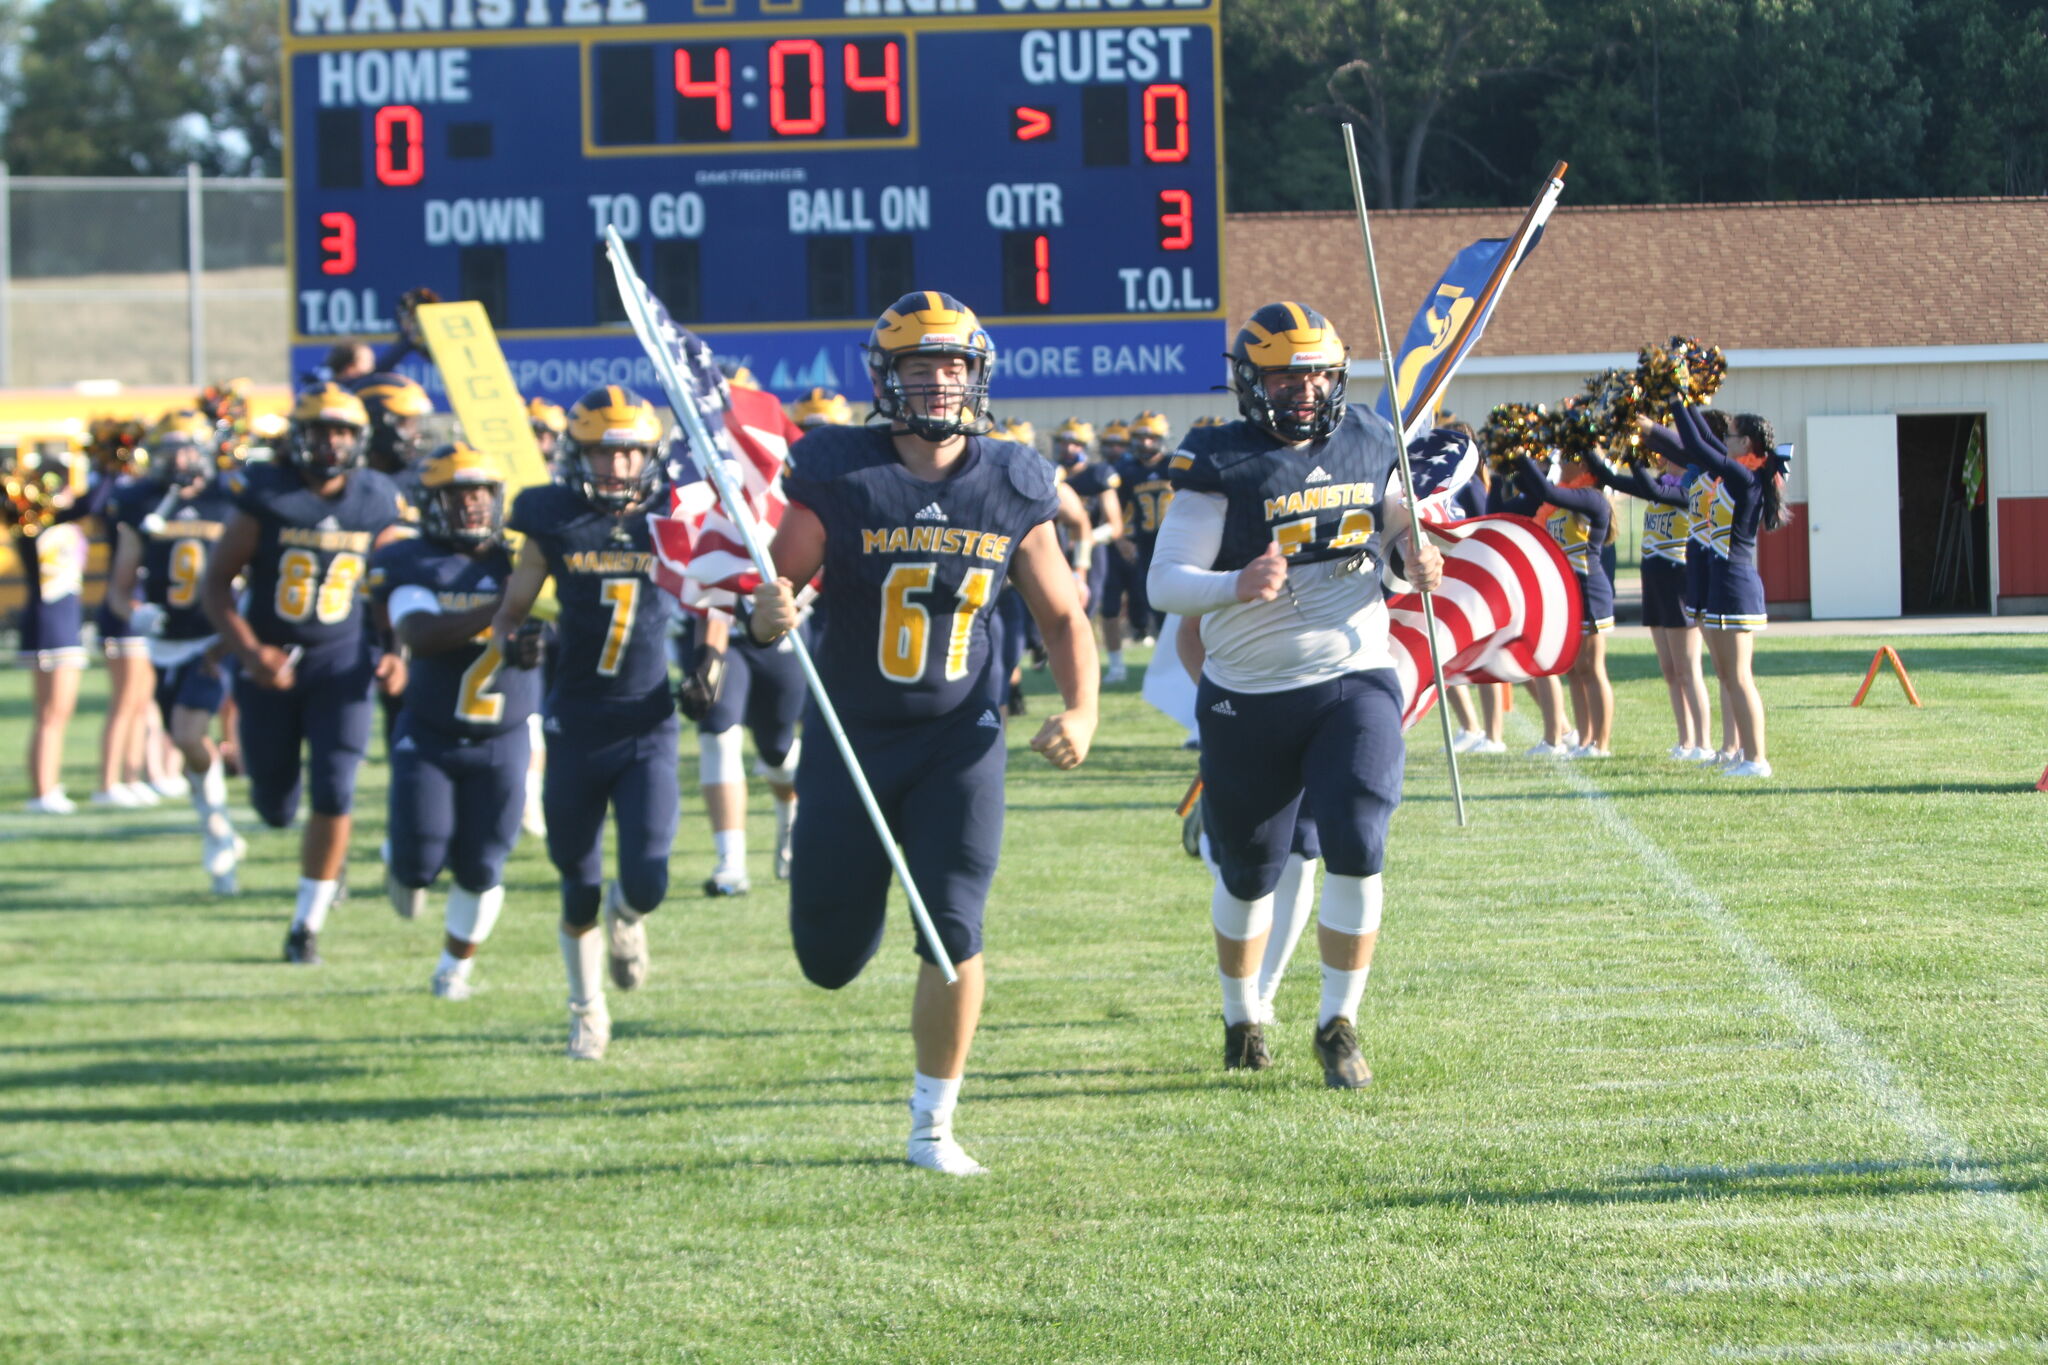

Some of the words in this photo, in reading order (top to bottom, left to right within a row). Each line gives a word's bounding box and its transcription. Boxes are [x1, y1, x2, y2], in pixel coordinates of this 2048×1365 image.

[318, 48, 470, 106] HOME
[1020, 27, 1191, 83] GUEST
[674, 40, 900, 135] 4:04
[375, 105, 424, 186] 0
[1143, 83, 1188, 162] 0
[425, 198, 542, 244] DOWN
[588, 194, 640, 239] TO
[650, 192, 704, 237] GO
[788, 187, 873, 232] BALL
[880, 187, 929, 230] ON
[986, 183, 1062, 228] QTR
[1160, 189, 1193, 250] 3
[321, 212, 356, 275] 3
[1035, 235, 1050, 305] 1
[301, 289, 394, 335] T.O.L.
[1119, 267, 1213, 312] T.O.L.
[1092, 345, 1184, 375] BANK
[915, 511, 948, 522] adidas
[1264, 482, 1374, 521] MANISTEE
[861, 526, 1012, 563] MANISTEE
[168, 540, 206, 608] 9
[597, 578, 641, 677] 7
[877, 562, 995, 684] 61
[454, 624, 506, 725] 2
